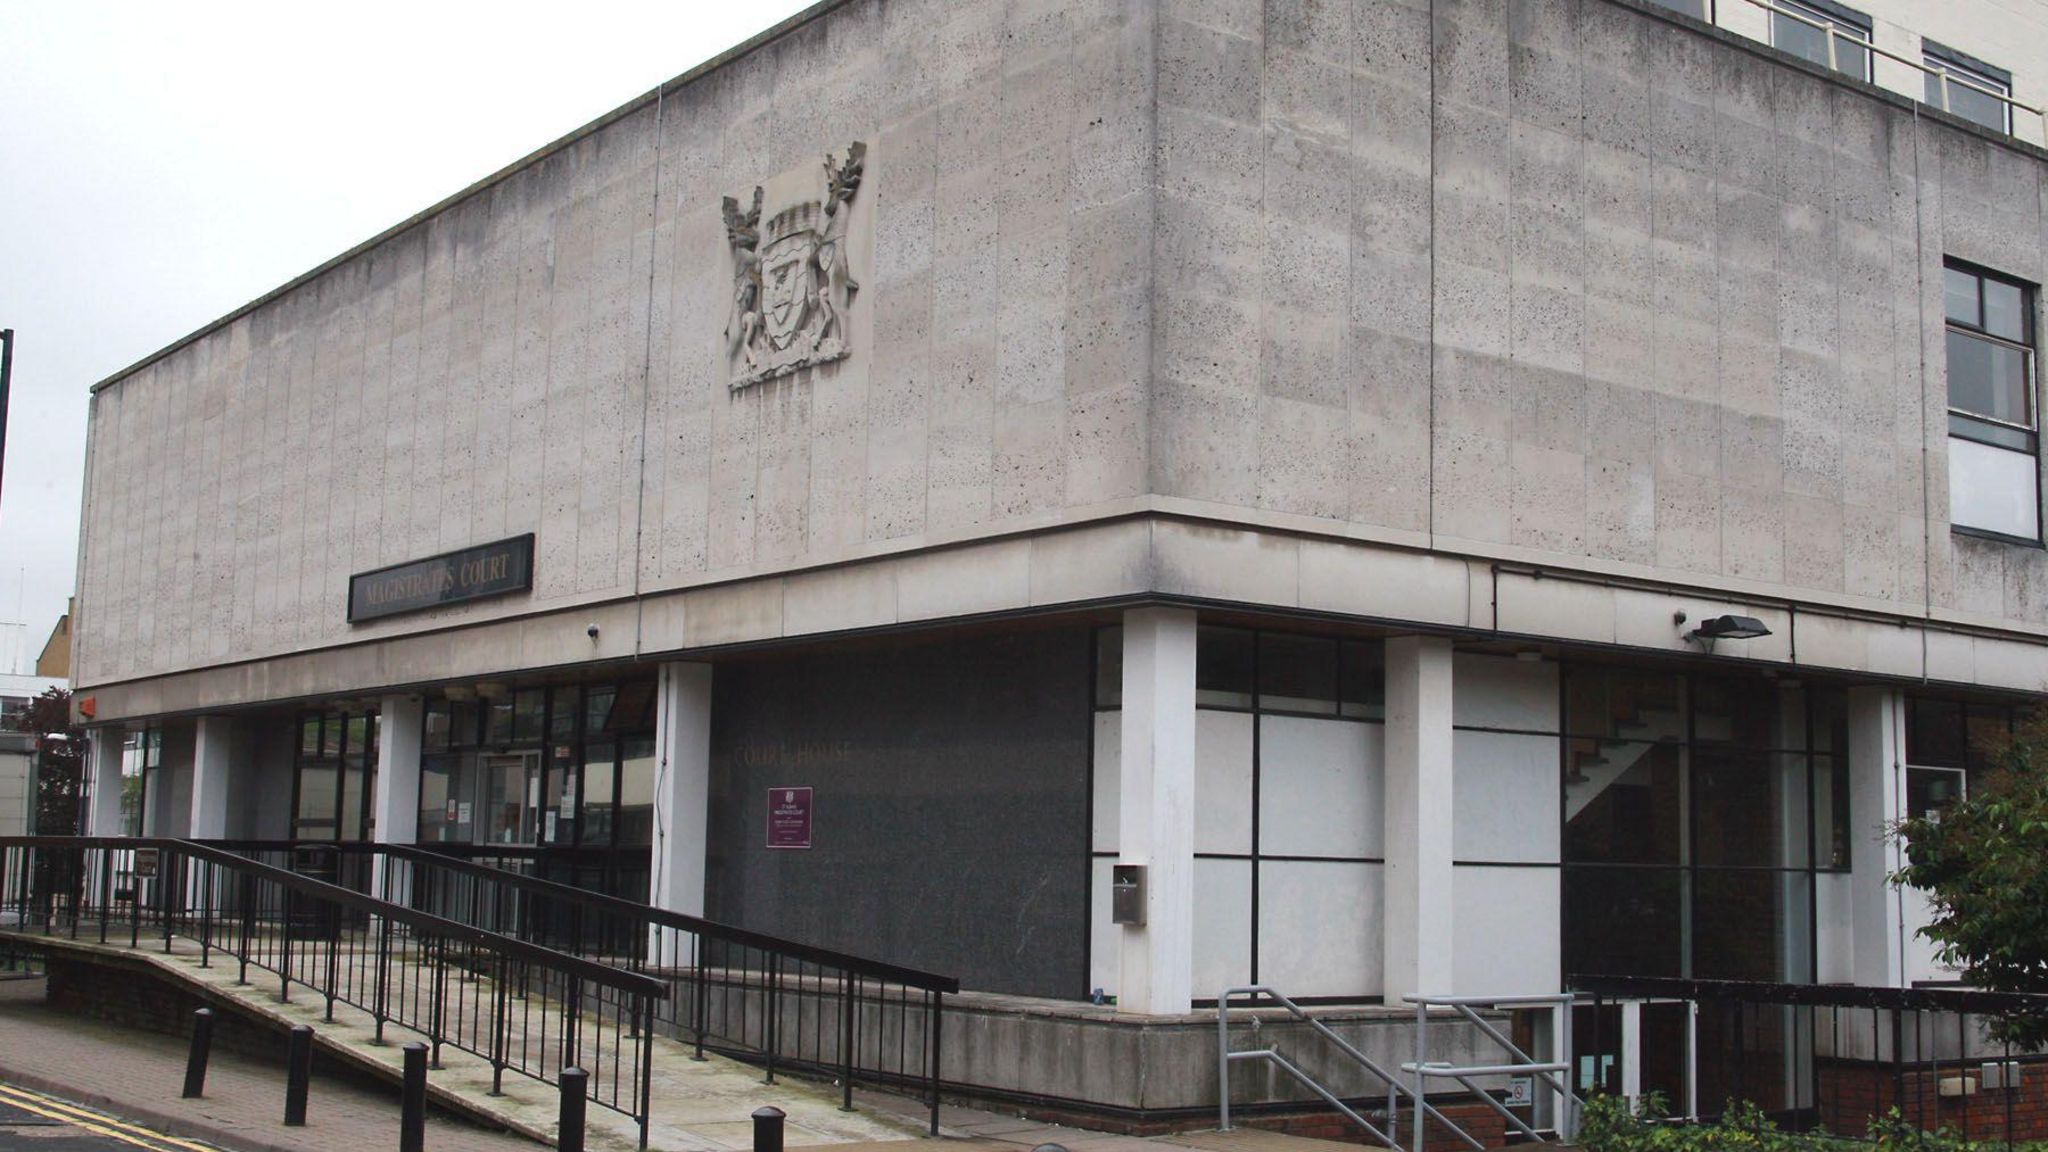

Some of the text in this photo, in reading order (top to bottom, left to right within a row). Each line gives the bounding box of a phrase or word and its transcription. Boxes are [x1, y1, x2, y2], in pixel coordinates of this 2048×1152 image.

[460, 554, 509, 588] COURT
[735, 741, 851, 767] COURT HOUSE
